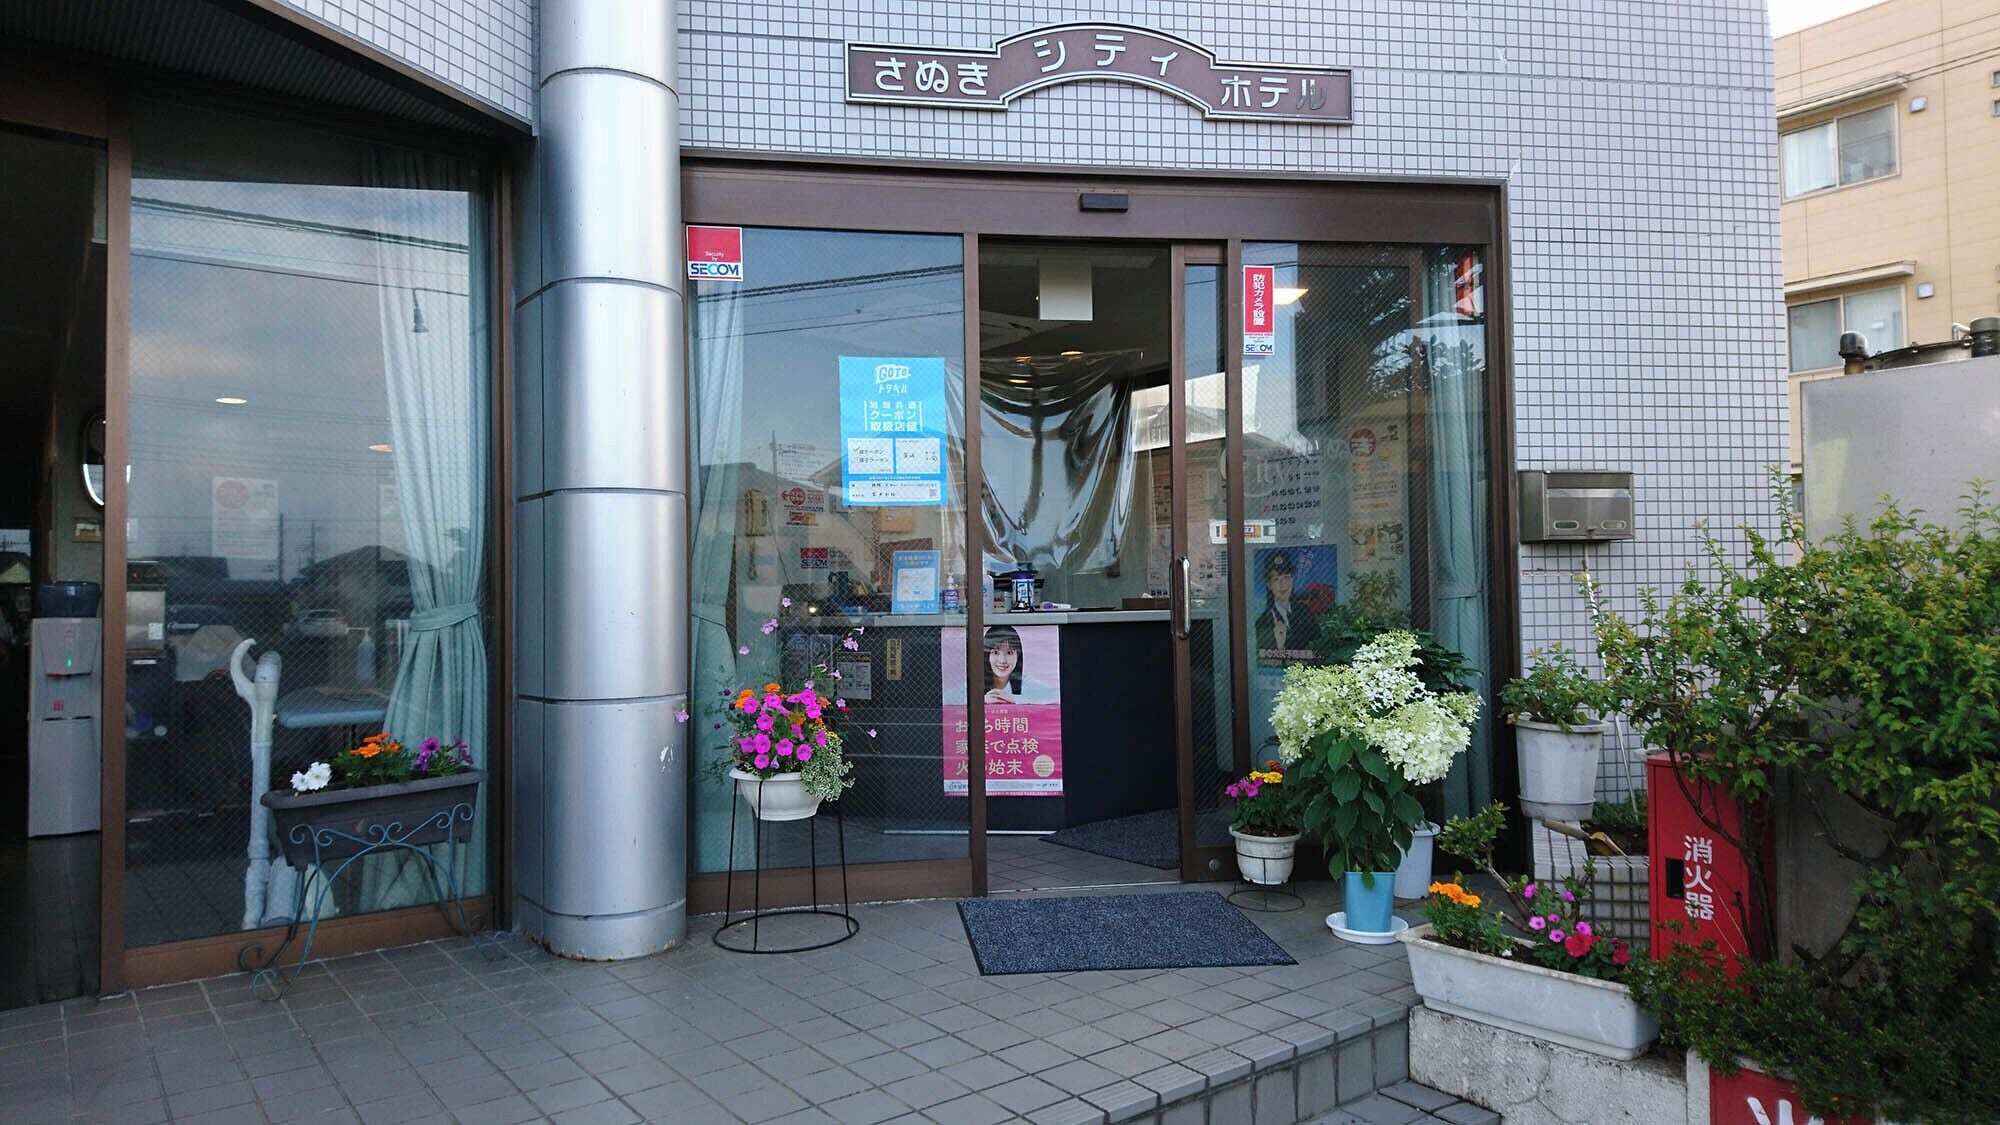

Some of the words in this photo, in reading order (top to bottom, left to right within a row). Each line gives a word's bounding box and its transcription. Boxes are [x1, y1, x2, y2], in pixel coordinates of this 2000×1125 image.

[874, 57, 988, 96] さぬき
[1033, 33, 1178, 77] シティ
[1221, 75, 1326, 111] ホテル
[691, 263, 739, 276] SECOM
[1253, 274, 1265, 326] 防犯カメラ設置
[870, 410, 917, 420] クーポン
[956, 717, 1029, 733] おち時間
[956, 758, 1024, 776] 火始末
[1684, 835, 1714, 921] 消火器
